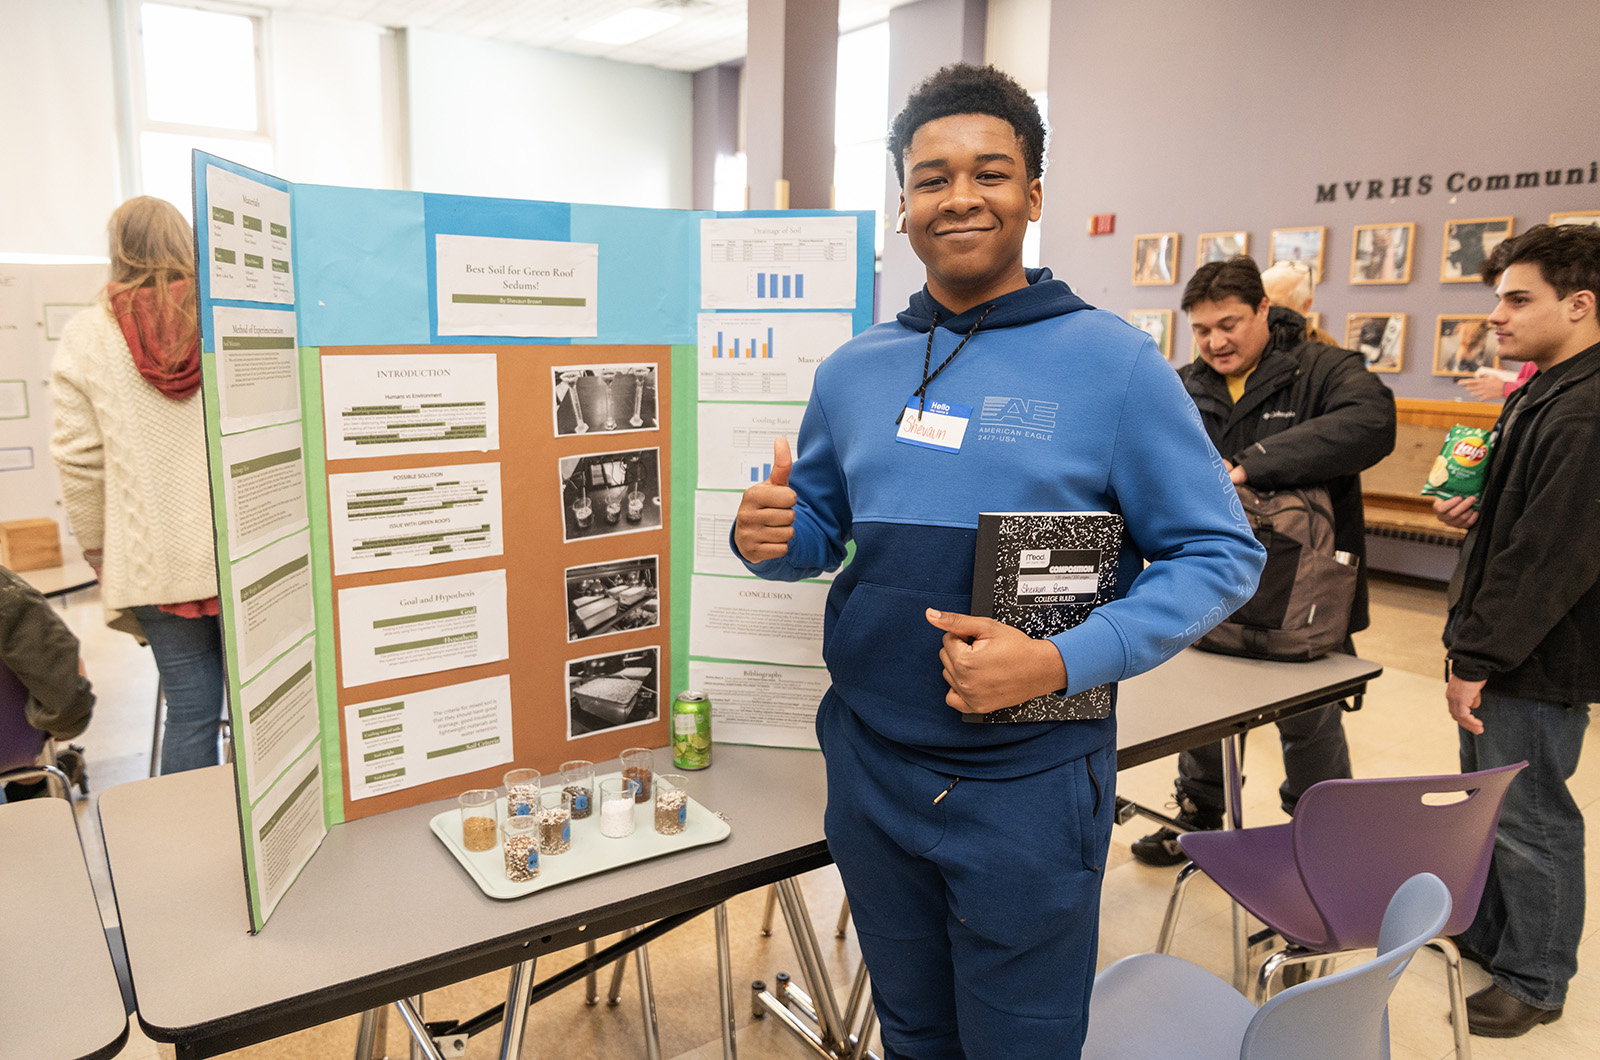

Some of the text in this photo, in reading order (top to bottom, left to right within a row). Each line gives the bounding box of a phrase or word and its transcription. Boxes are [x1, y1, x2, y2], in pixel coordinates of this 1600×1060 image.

[1315, 161, 1599, 203] MVRHS Communi
[754, 227, 780, 235] Drainage
[466, 264, 575, 278] Best Soil for Green Roof
[503, 280, 539, 290] Sedums!
[377, 369, 451, 378] INTRODUCTION
[931, 401, 951, 412] Hello
[752, 417, 776, 425] Cooling
[979, 427, 1052, 441] AMERICAN EAGLE
[1049, 565, 1094, 573] COMPOSITION
[400, 591, 475, 606] Goal and Hypothesis
[739, 591, 792, 600] CONCLUSION
[460, 607, 476, 615] Goal
[444, 633, 477, 643] Hypothesis
[743, 670, 782, 678] Bibliography
